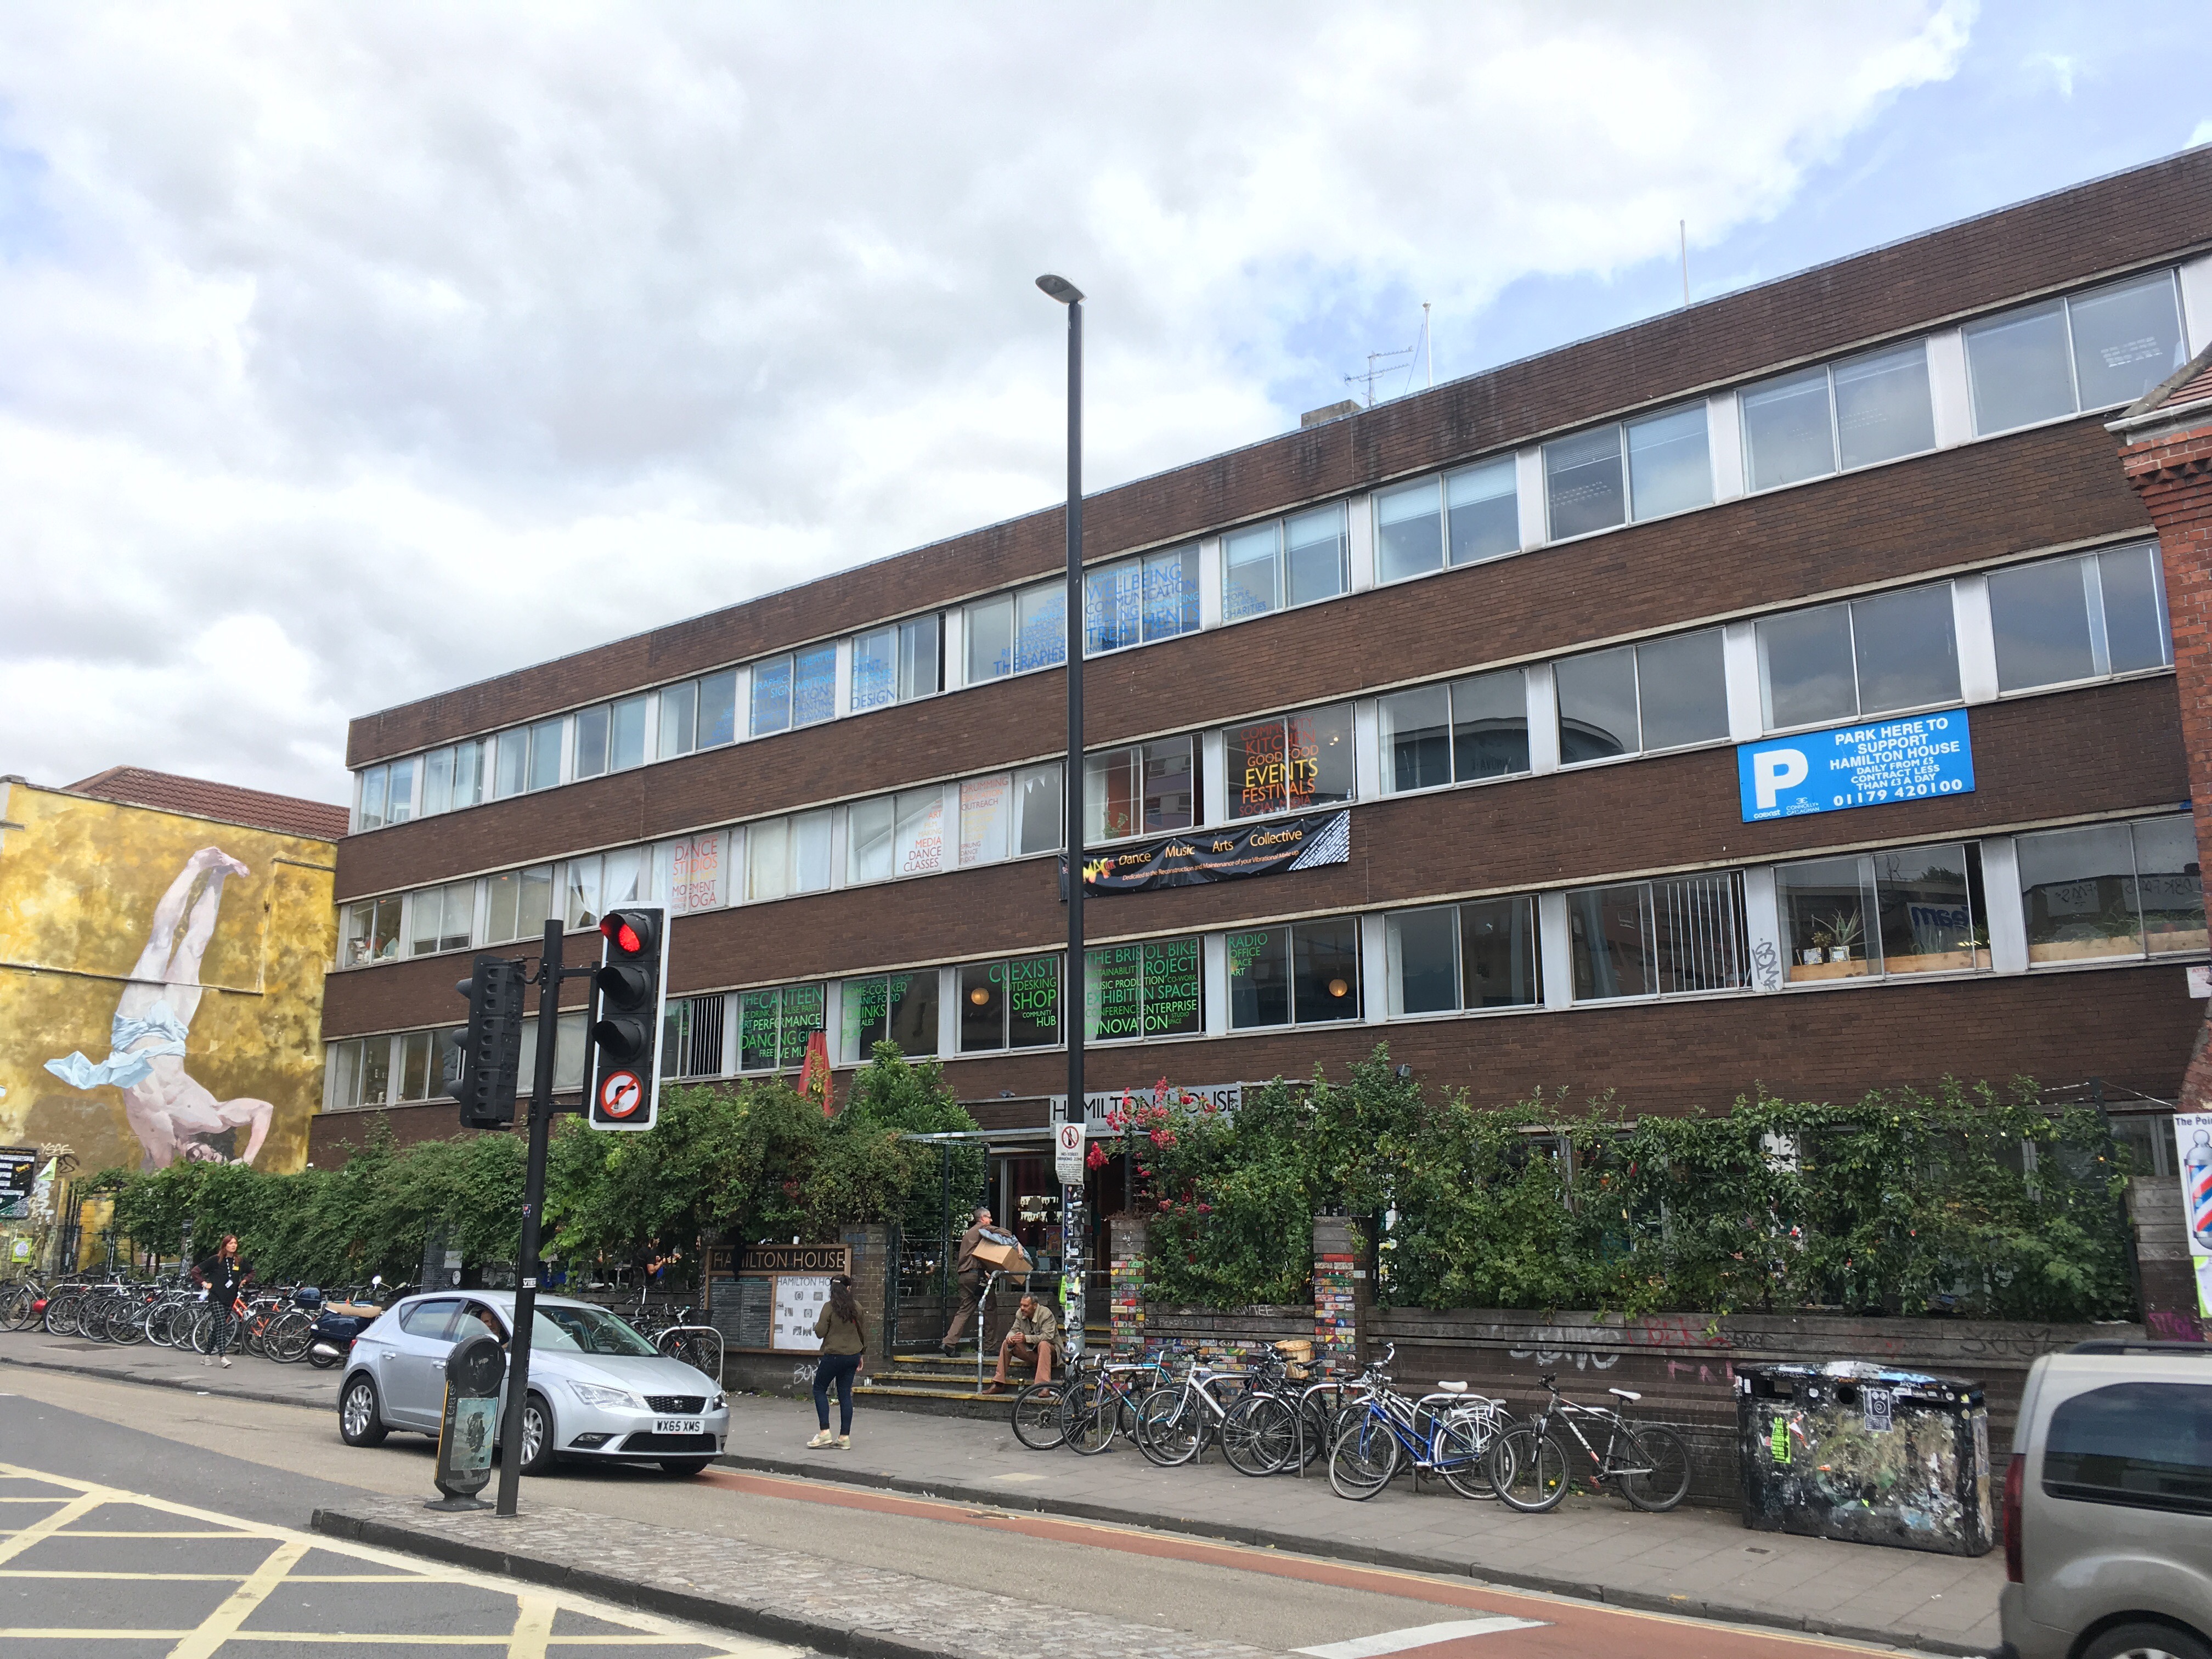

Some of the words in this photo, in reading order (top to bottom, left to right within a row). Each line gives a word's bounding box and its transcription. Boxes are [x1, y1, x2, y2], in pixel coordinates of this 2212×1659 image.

[1087, 563, 1181, 601] WELLBEING
[1087, 578, 1196, 615] COMMUNICATION
[1224, 601, 1266, 619] CHARITIES
[1086, 602, 1200, 645] TREATMENTS
[994, 646, 1066, 675] THERAPIES
[753, 673, 791, 691] GRAPHICS
[851, 689, 895, 710] DESIGN
[1240, 716, 1314, 741] COMMUNITY
[1835, 729, 1876, 746] PARK
[1881, 721, 1924, 738] HERE
[1926, 718, 1949, 731] TO
[1246, 728, 1316, 756] KITCHEN
[1858, 733, 1929, 754] SUPPORT
[1247, 751, 1283, 767] GOOD
[1288, 744, 1319, 759] OOD
[1830, 749, 1903, 770] HAMILTON
[1908, 741, 1961, 759] HOUSE
[1245, 758, 1318, 788] EVENTS
[1850, 768, 1911, 783] CONTRACT
[1914, 764, 1940, 775] LESS
[1857, 764, 1887, 775] DAILY
[1890, 759, 1920, 770] FROM
[1923, 757, 1934, 765] £5
[962, 777, 1008, 794] DRUMMING
[1753, 748, 1809, 809] P
[1857, 780, 1888, 791] THAN
[1891, 778, 1901, 787] £3
[1904, 777, 1912, 785] A
[1914, 773, 1936, 783] DAY
[962, 788, 1003, 803] EDUCATION
[1242, 777, 1316, 804] FESTIVALS
[1833, 789, 1887, 806] 01179
[1894, 779, 1963, 798] 420100
[962, 798, 999, 811] OUTREACH
[1239, 801, 1276, 817] SOCIAL
[928, 810, 943, 819] ART
[1753, 809, 1781, 819] coexist
[675, 838, 718, 861] DANCE
[915, 837, 941, 849] MEDIA
[960, 848, 979, 856] DANCE
[1119, 852, 1152, 866] Dance
[1165, 844, 1196, 858] Music
[1212, 840, 1234, 853] Arts
[1250, 830, 1303, 847] Collective
[909, 846, 941, 860] DANCE
[904, 857, 939, 872] CLASSES
[1122, 871, 1145, 881] Dedicated
[1159, 866, 1194, 876] Reconstruction
[1203, 859, 1235, 869] Maintenance
[1240, 859, 1251, 867] your
[1251, 854, 1278, 864] Vibrational
[672, 879, 716, 897] MOEMENT
[1228, 933, 1268, 949] RADIO
[1086, 950, 1111, 966] THE
[1116, 944, 1164, 963] BRISOL
[1168, 940, 1197, 957] BIKE
[1230, 946, 1261, 958] OFFICE
[989, 957, 1057, 983] COEXIST
[1085, 965, 1139, 978] SUSTAINABILITY
[1167, 974, 1197, 983] CO-WORK
[1231, 967, 1245, 976] ART
[1090, 981, 1113, 990] MUSIC
[1115, 975, 1165, 988] PRODUTION
[1158, 982, 1198, 999] SPACE
[741, 993, 758, 1005] THE
[759, 987, 822, 1009] CANTEEN
[878, 993, 900, 1003] FOOD
[1013, 989, 1057, 1010] SHOP
[1143, 999, 1197, 1015] ENTERPRISE
[802, 1003, 821, 1013] PARTY
[847, 1004, 886, 1020] DRINKS
[1022, 1009, 1052, 1018] COMMUNITY
[1085, 1003, 1140, 1018] CONFERENCE
[753, 1013, 821, 1031] PERFORMANCE
[1036, 1015, 1057, 1027] HUB
[1085, 1014, 1168, 1035] INNOVAON
[740, 1030, 797, 1049] DANCNG
[759, 1048, 774, 1058] FREE
[774, 1047, 789, 1059] LVE
[1053, 1095, 1156, 1120] HMILTON
[1160, 1090, 1237, 1114] OUSE
[2175, 1118, 2192, 1126] The
[714, 1252, 788, 1268] HAILTON
[793, 1251, 844, 1268] HOUSE
[777, 1277, 817, 1286] HAMILTON
[657, 1420, 681, 1432] WX65
[683, 1420, 700, 1432] XMS
